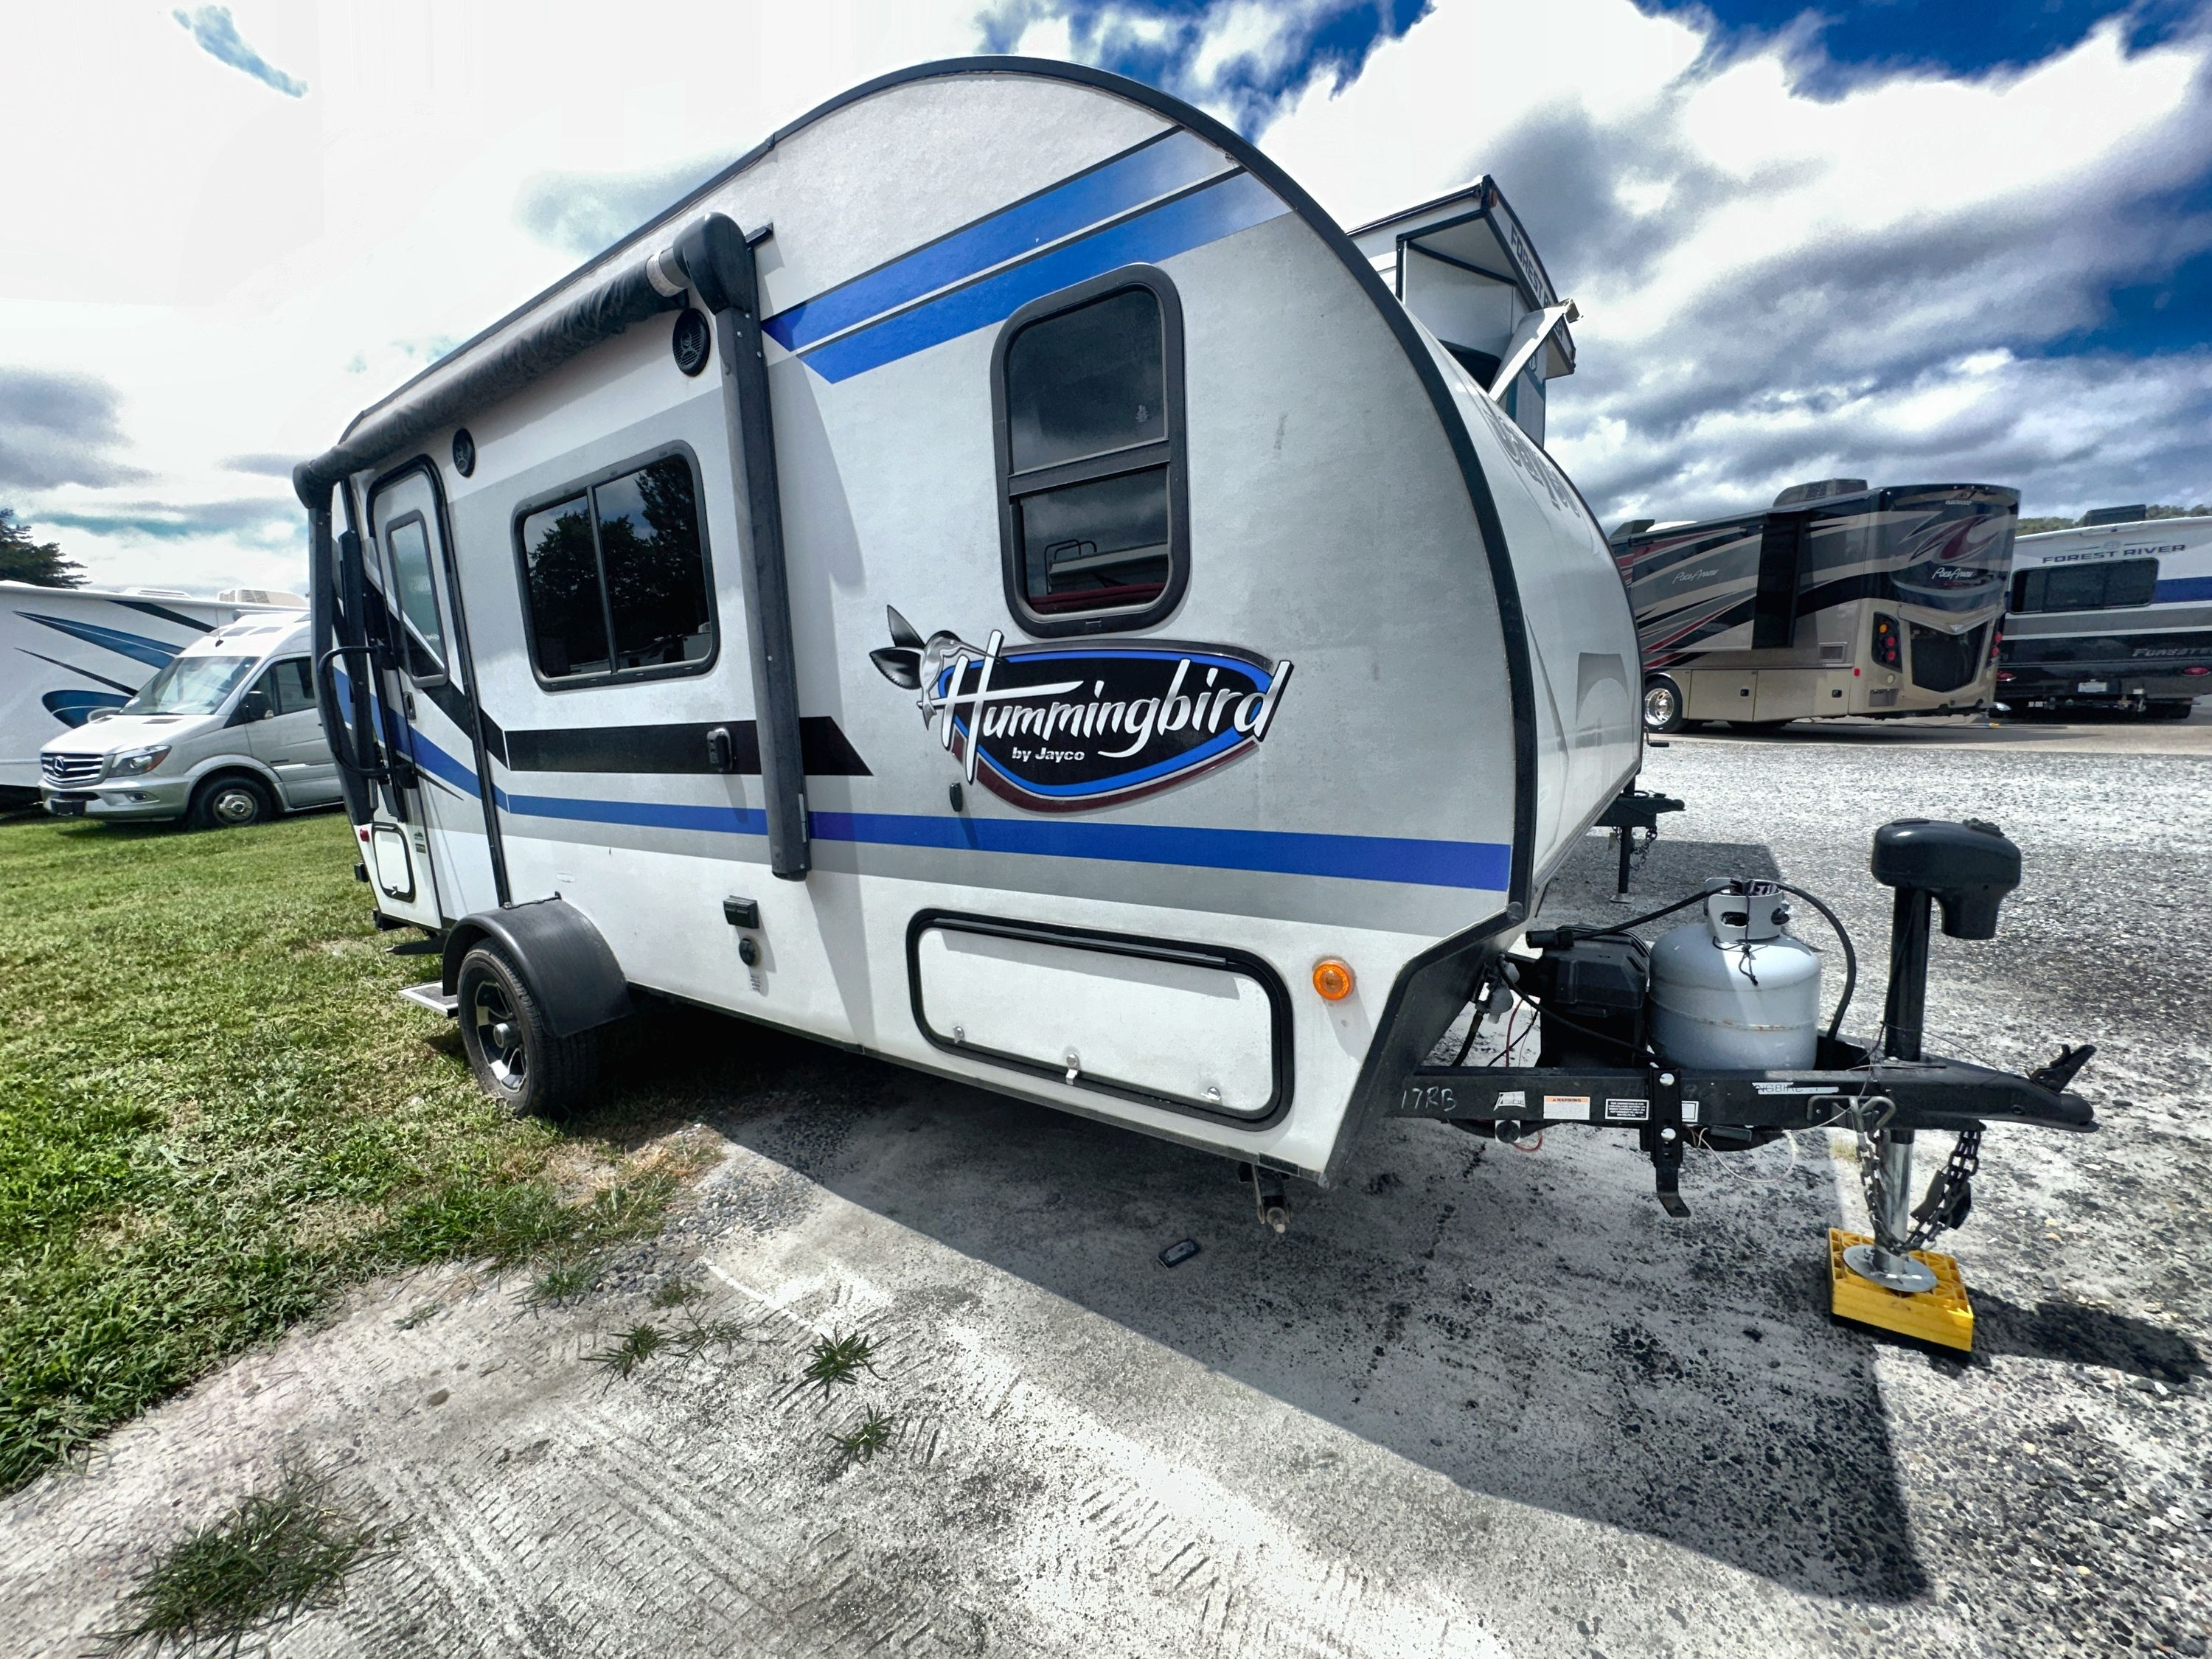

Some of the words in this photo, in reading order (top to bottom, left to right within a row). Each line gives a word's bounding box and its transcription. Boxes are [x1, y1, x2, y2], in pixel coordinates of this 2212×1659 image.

[1510, 222, 1543, 299] FOREST
[2042, 551, 2118, 564] FOREST
[2123, 544, 2186, 556] RIVER
[918, 629, 1294, 785] Hummingbird
[1012, 746, 1032, 762] by
[1034, 747, 1085, 763] Jayco
[1401, 1085, 1457, 1112] 17RB
